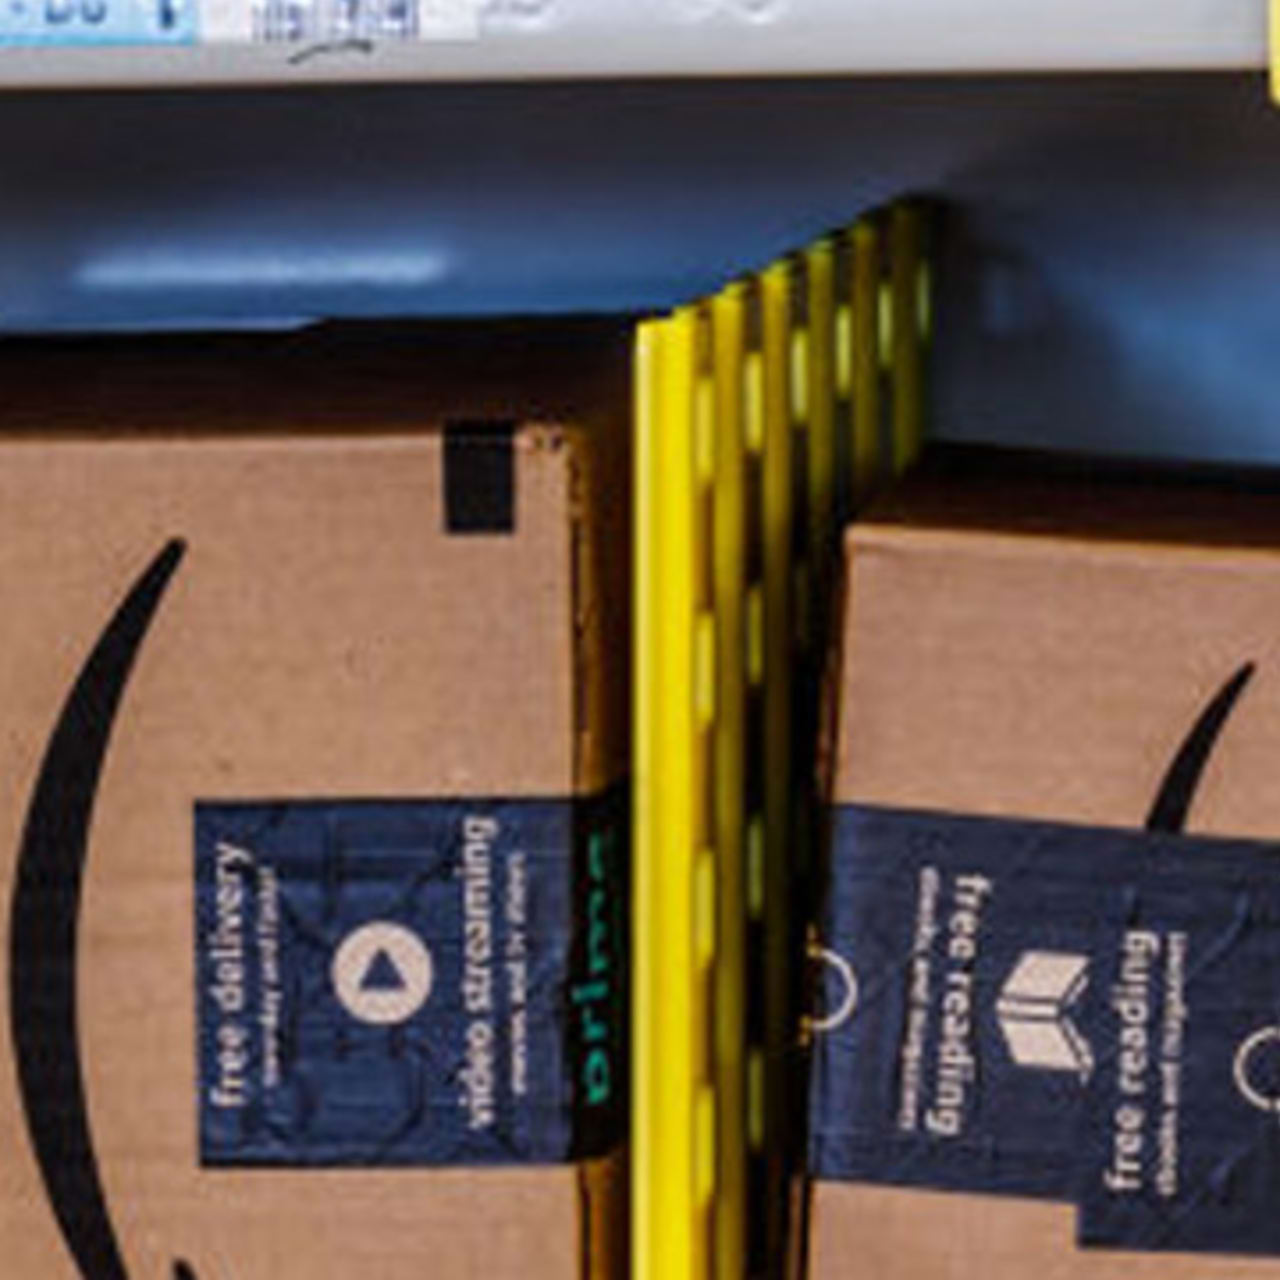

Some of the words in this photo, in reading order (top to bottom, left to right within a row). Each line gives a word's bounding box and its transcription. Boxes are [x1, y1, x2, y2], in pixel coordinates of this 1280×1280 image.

[209, 841, 251, 1012] delivery
[455, 815, 498, 1012] streaming
[949, 873, 990, 962] free
[210, 1023, 249, 1107] free
[458, 1021, 496, 1129] video
[926, 971, 979, 1137] reading
[1111, 929, 1161, 1094] reading
[1104, 1107, 1145, 1191] free
